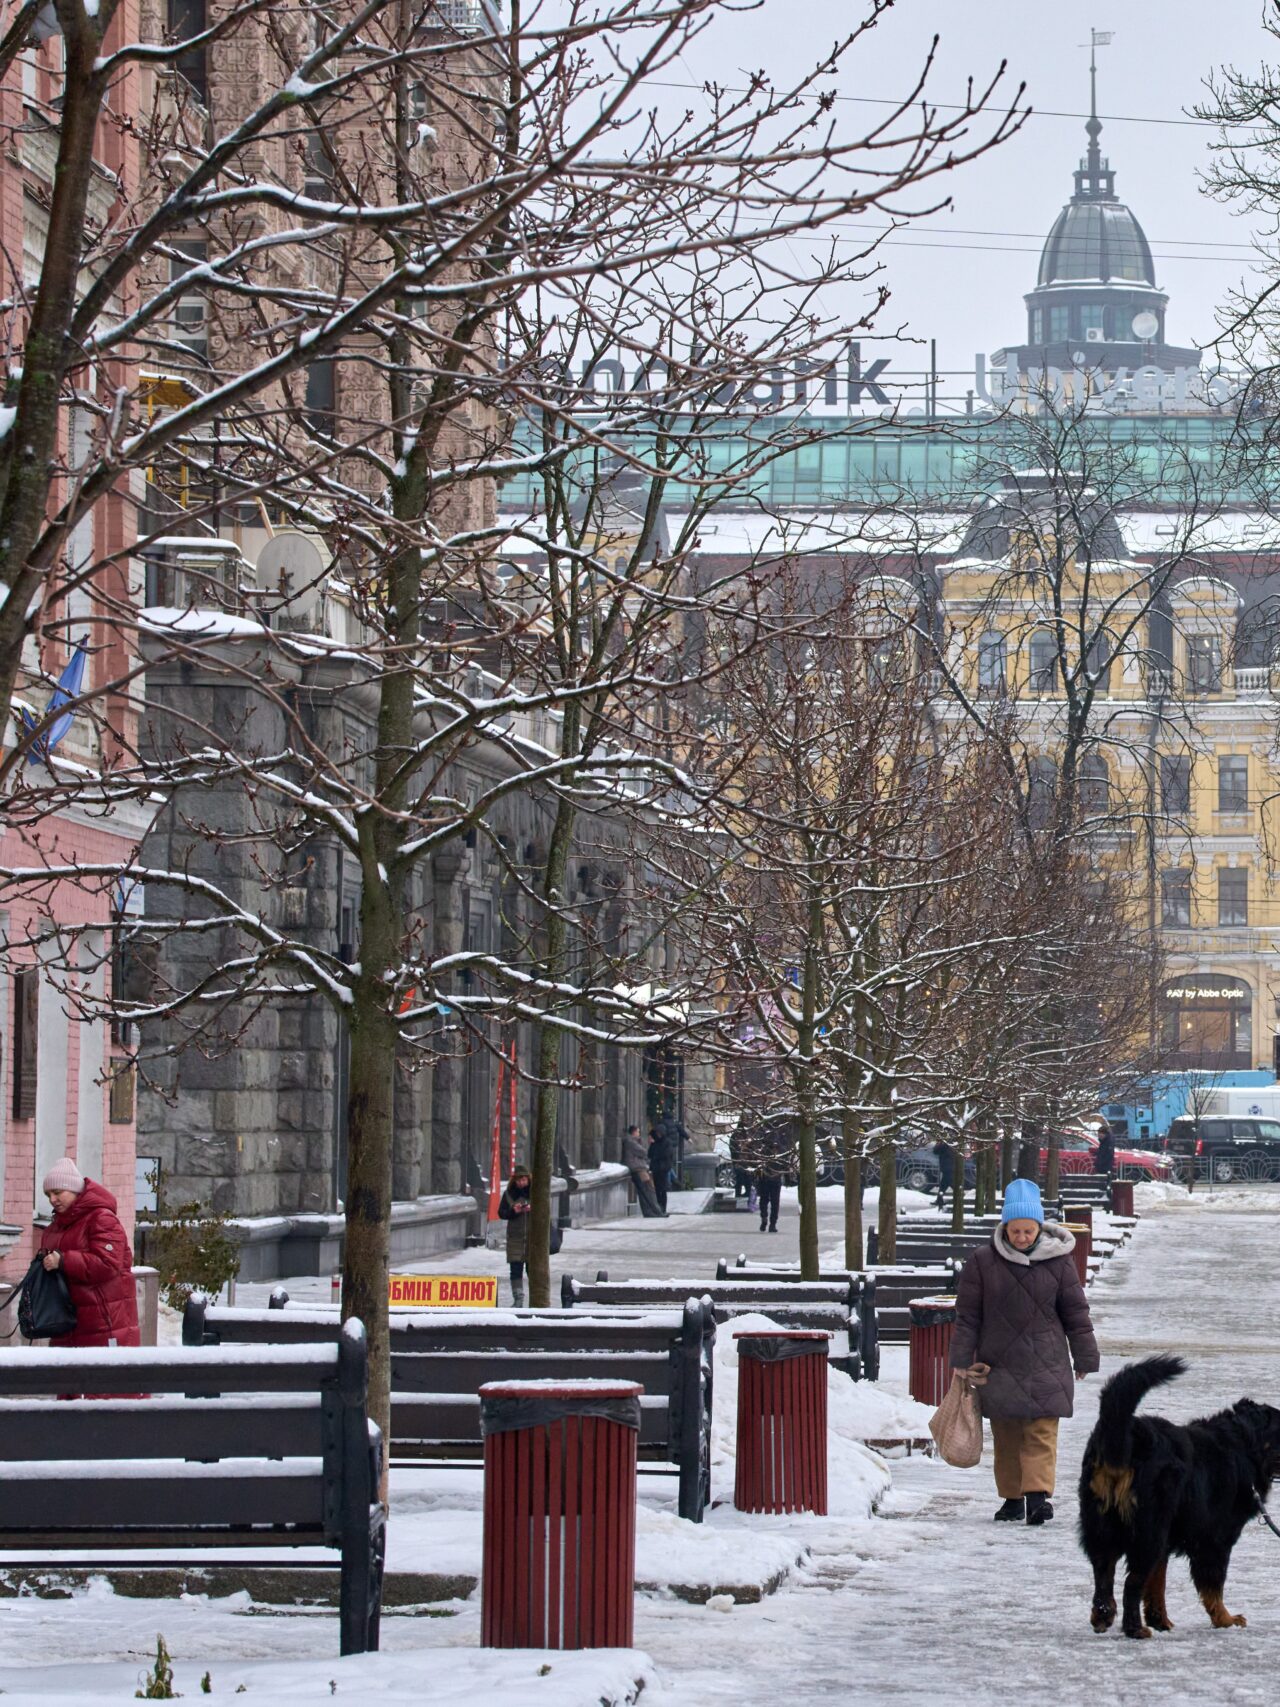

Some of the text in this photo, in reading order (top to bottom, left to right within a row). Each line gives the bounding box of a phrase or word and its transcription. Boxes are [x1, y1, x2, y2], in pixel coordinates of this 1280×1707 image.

[1185, 987, 1196, 999] by
[1197, 987, 1220, 998] Abbe
[439, 1281, 495, 1301] ВАЛЮТ
